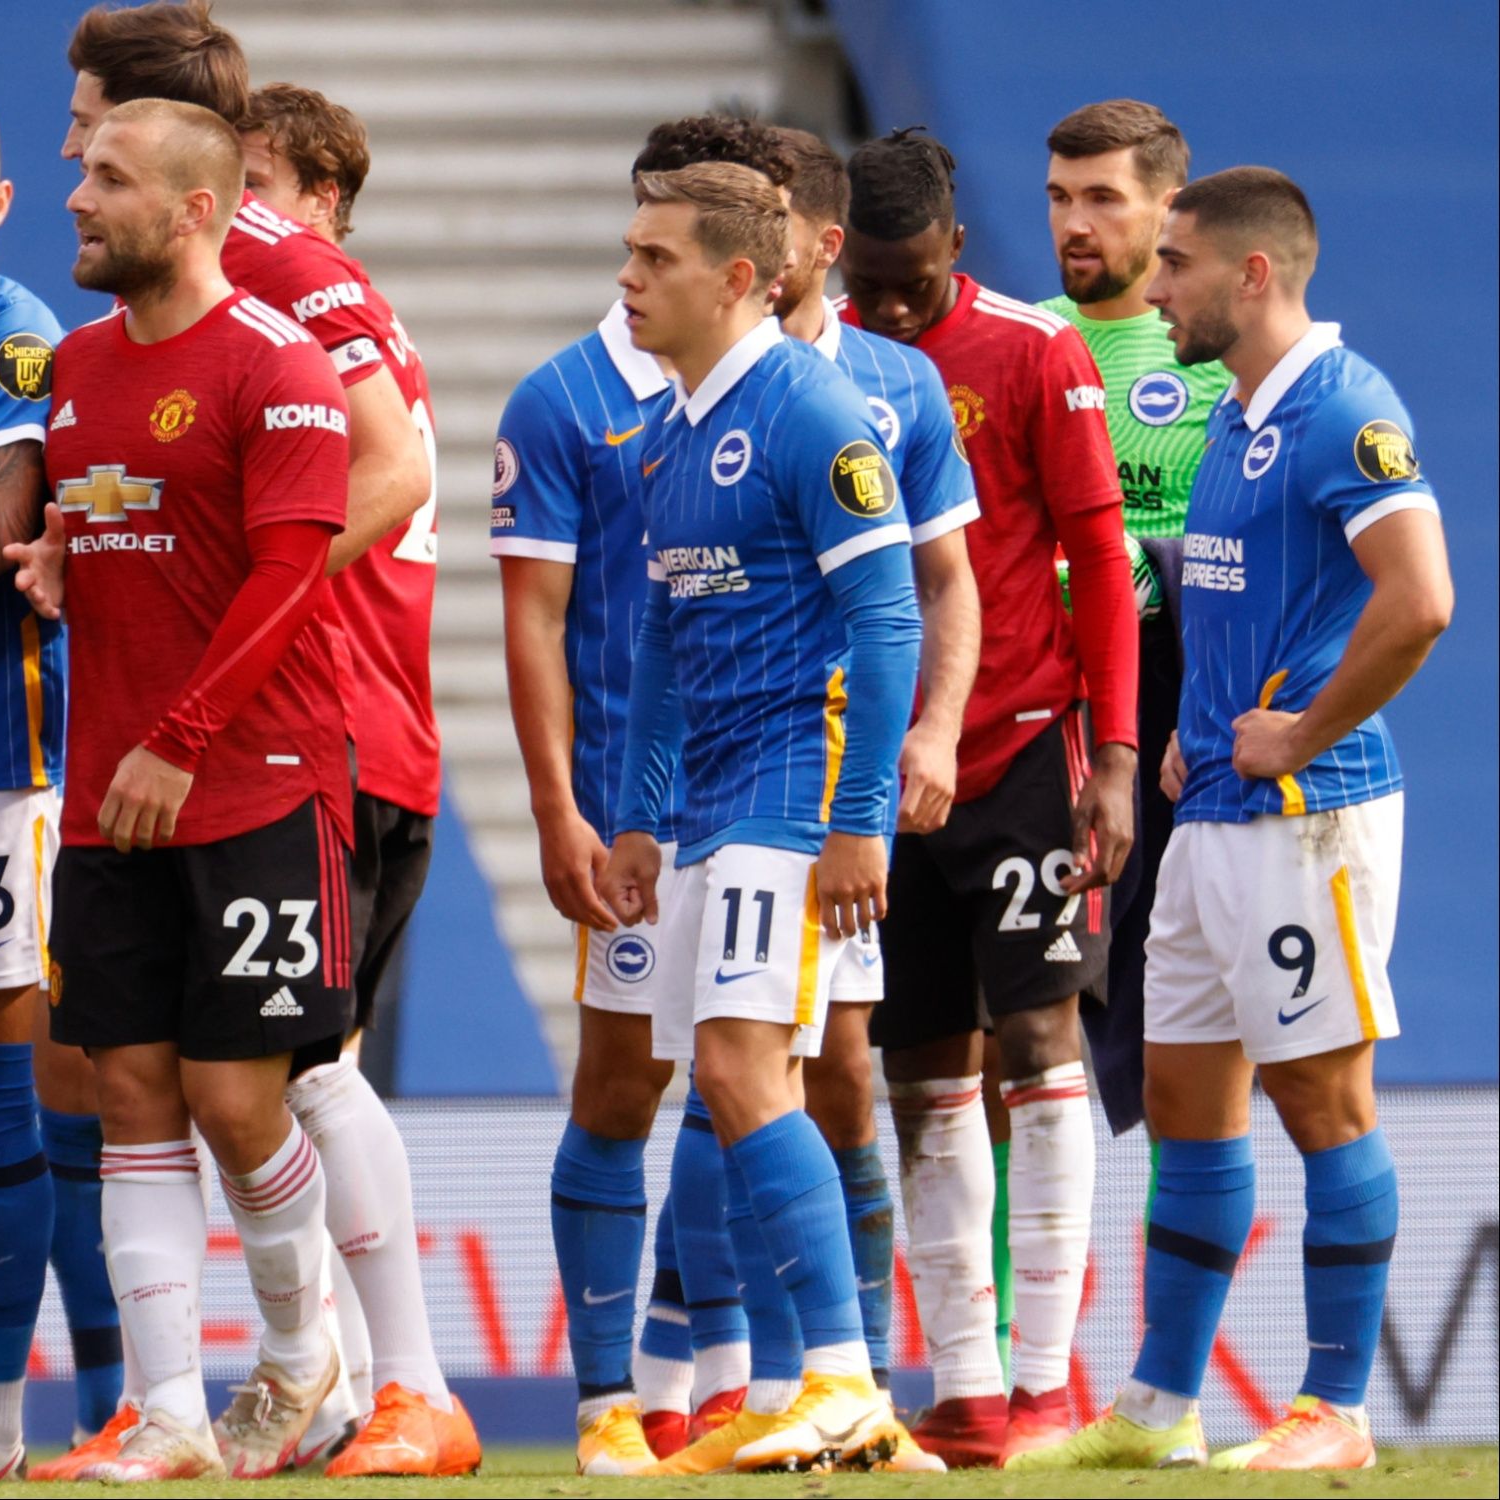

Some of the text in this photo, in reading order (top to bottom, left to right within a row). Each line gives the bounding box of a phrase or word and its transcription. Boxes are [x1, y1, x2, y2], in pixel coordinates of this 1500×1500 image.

[264, 404, 347, 437] KOHLER
[854, 468, 883, 497] UK
[657, 545, 741, 573] MERICAN
[1183, 533, 1243, 564] MERICAN
[992, 848, 1083, 932] 29
[221, 897, 319, 979] 23
[722, 887, 775, 963] 11
[1044, 950, 1082, 962] adidas
[1268, 924, 1315, 1000] 9
[260, 1005, 304, 1017] adidas
